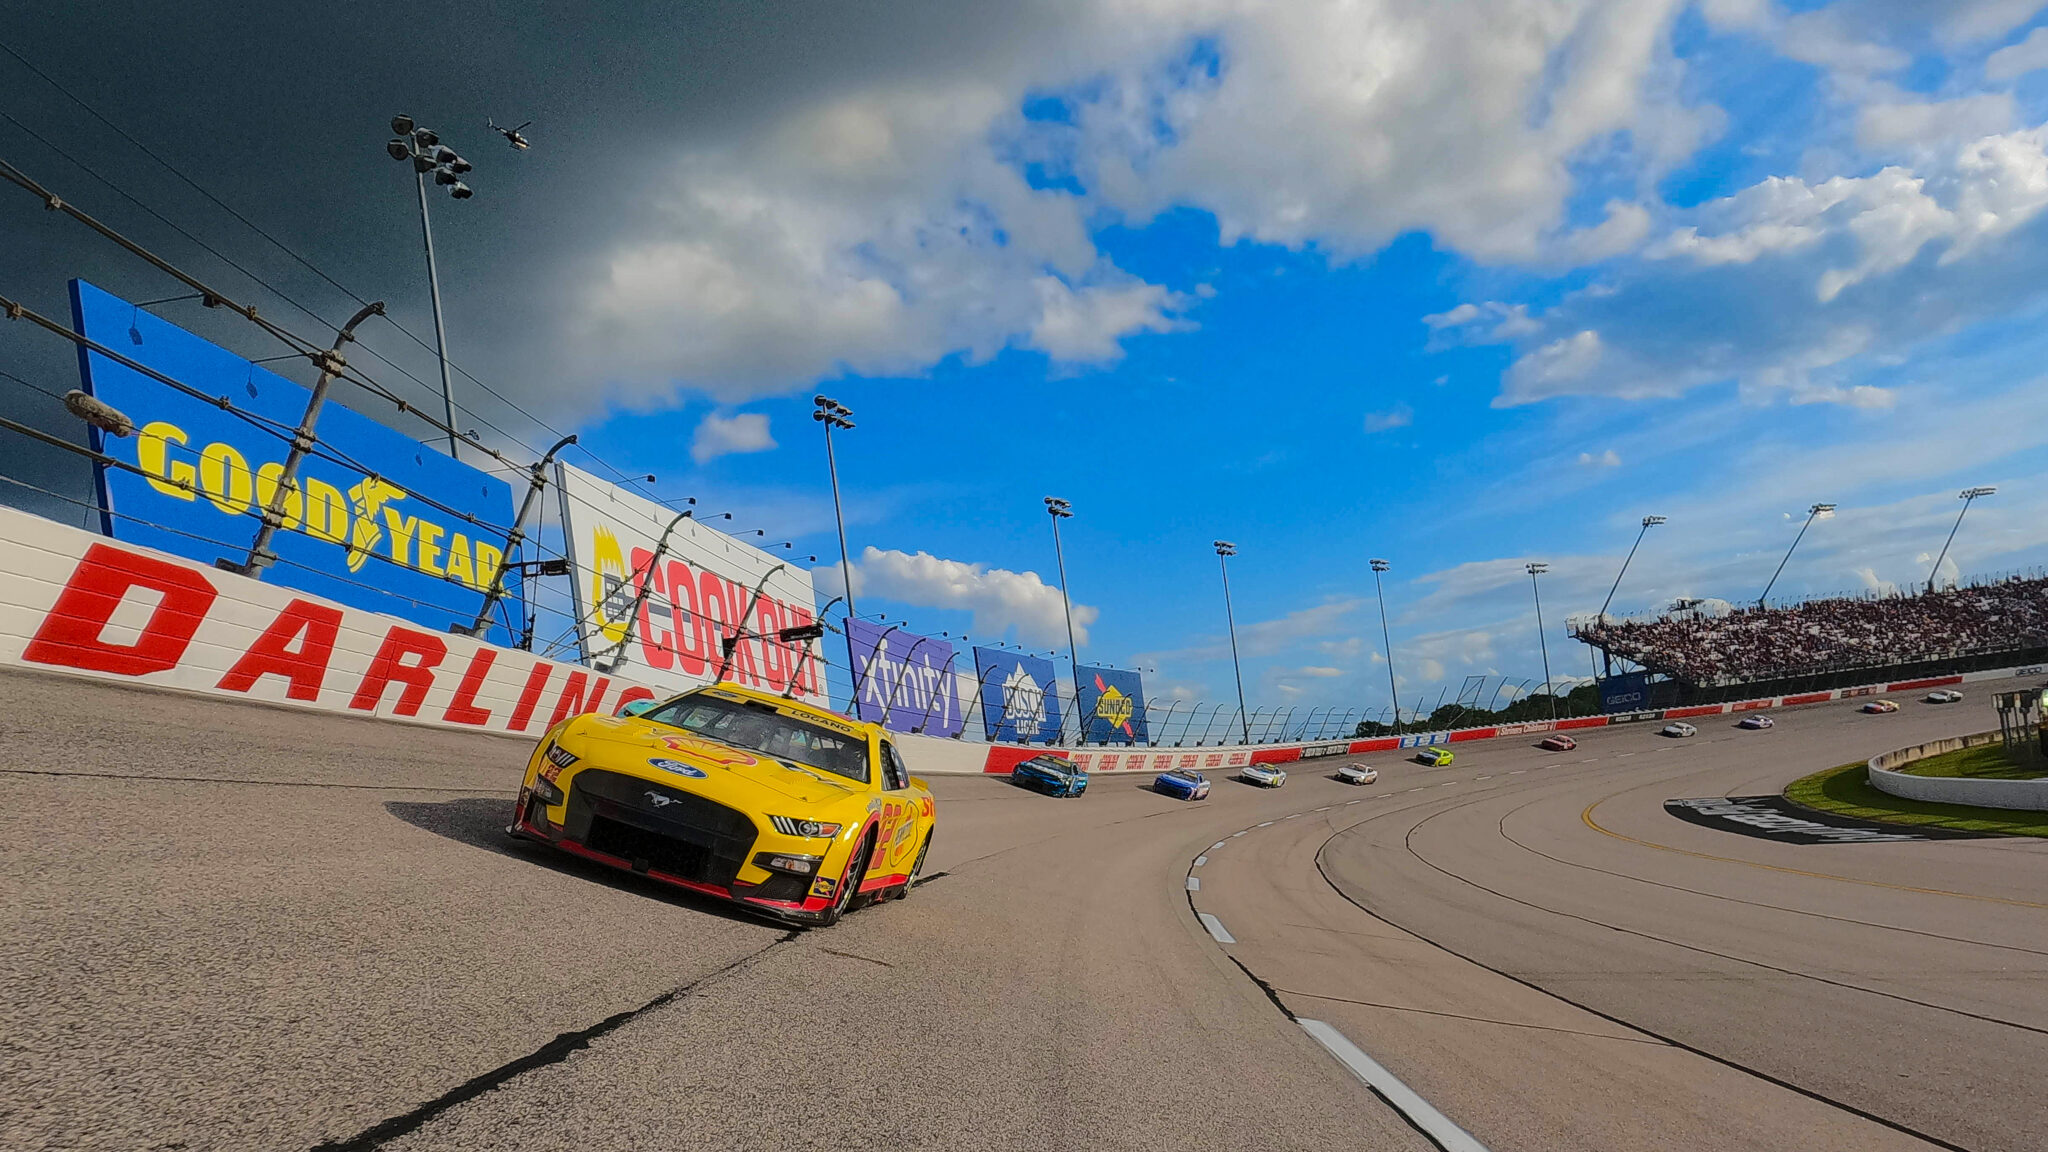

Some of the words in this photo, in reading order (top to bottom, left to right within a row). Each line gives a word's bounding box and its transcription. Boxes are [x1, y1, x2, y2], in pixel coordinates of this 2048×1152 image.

[137, 420, 512, 599] GOODYEAR
[631, 546, 760, 687] COOK
[860, 638, 952, 729] xfinity
[1002, 684, 1047, 722] BUSCH
[1098, 698, 1132, 716] SUNOCO
[1606, 691, 1641, 705] GEICO
[791, 710, 852, 733] LOGANO
[1016, 719, 1040, 735] LIGHT
[657, 760, 698, 776] Ford
